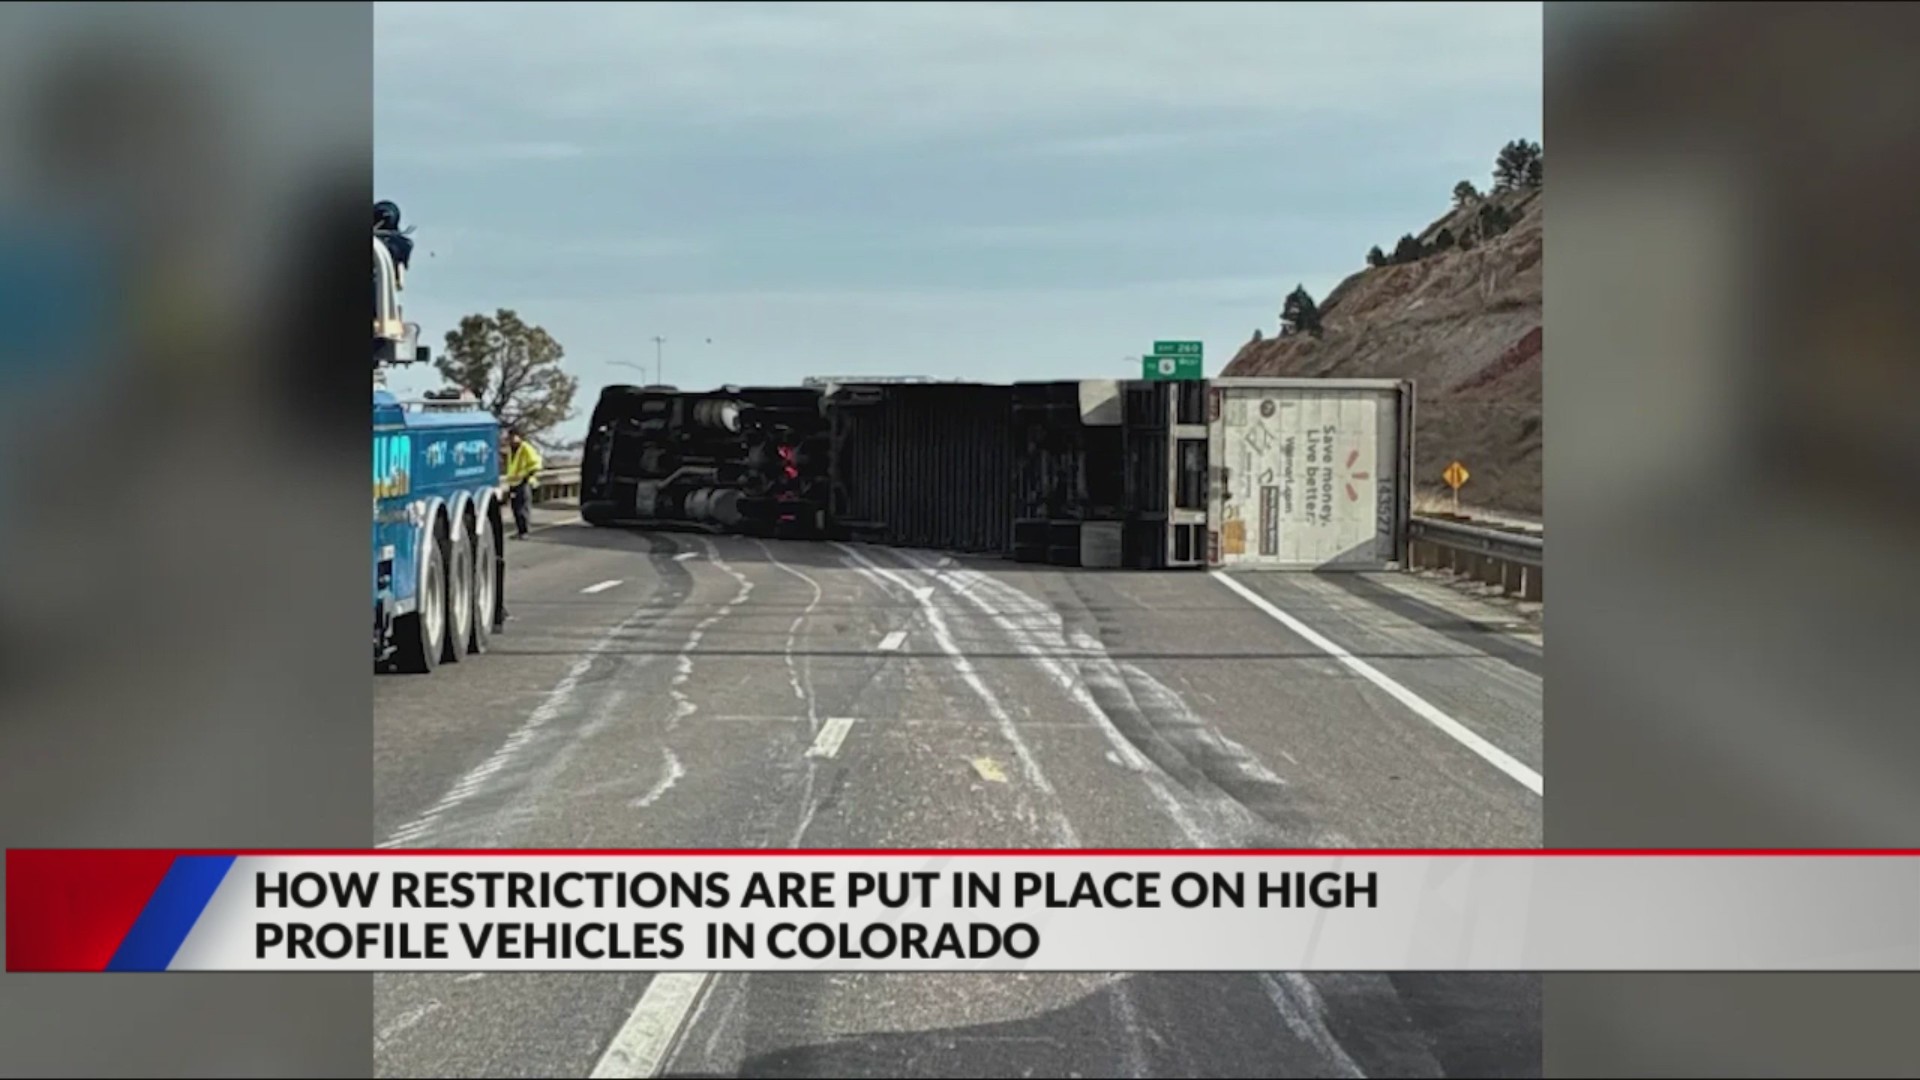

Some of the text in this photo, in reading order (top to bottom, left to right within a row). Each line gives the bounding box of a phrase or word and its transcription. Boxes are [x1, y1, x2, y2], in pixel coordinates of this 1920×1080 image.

[1178, 344, 1199, 353] 260
[1305, 429, 1320, 523] Live better.
[1319, 425, 1336, 527] Save money.
[1377, 477, 1392, 536] 143527
